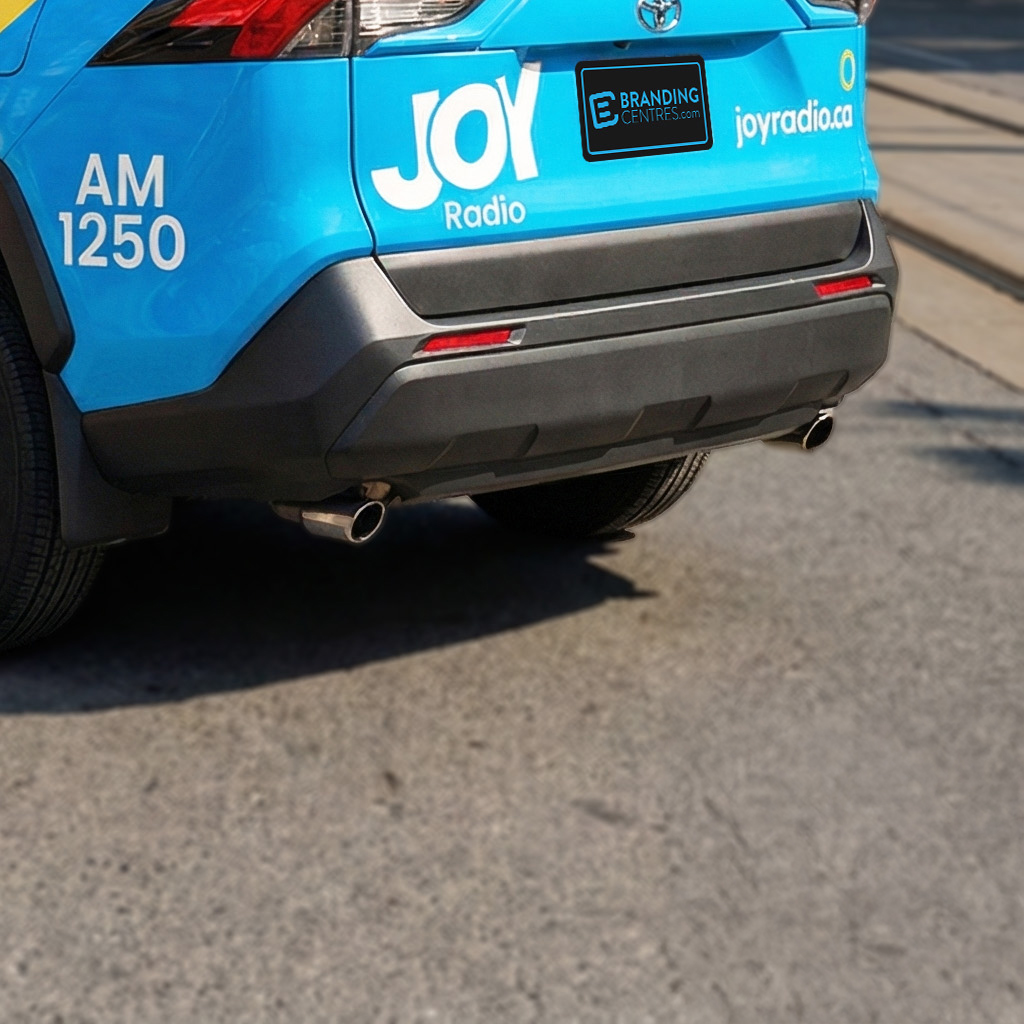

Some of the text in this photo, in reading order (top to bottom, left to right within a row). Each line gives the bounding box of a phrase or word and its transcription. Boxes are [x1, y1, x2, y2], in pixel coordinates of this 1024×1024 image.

[620, 87, 699, 108] BRANDING
[621, 106, 701, 124] CENTRES.com
[371, 61, 542, 211] JOY
[735, 99, 853, 149] joyradio.ca
[75, 153, 165, 208] AM
[445, 195, 526, 230] Radio
[59, 212, 186, 271] 1250
